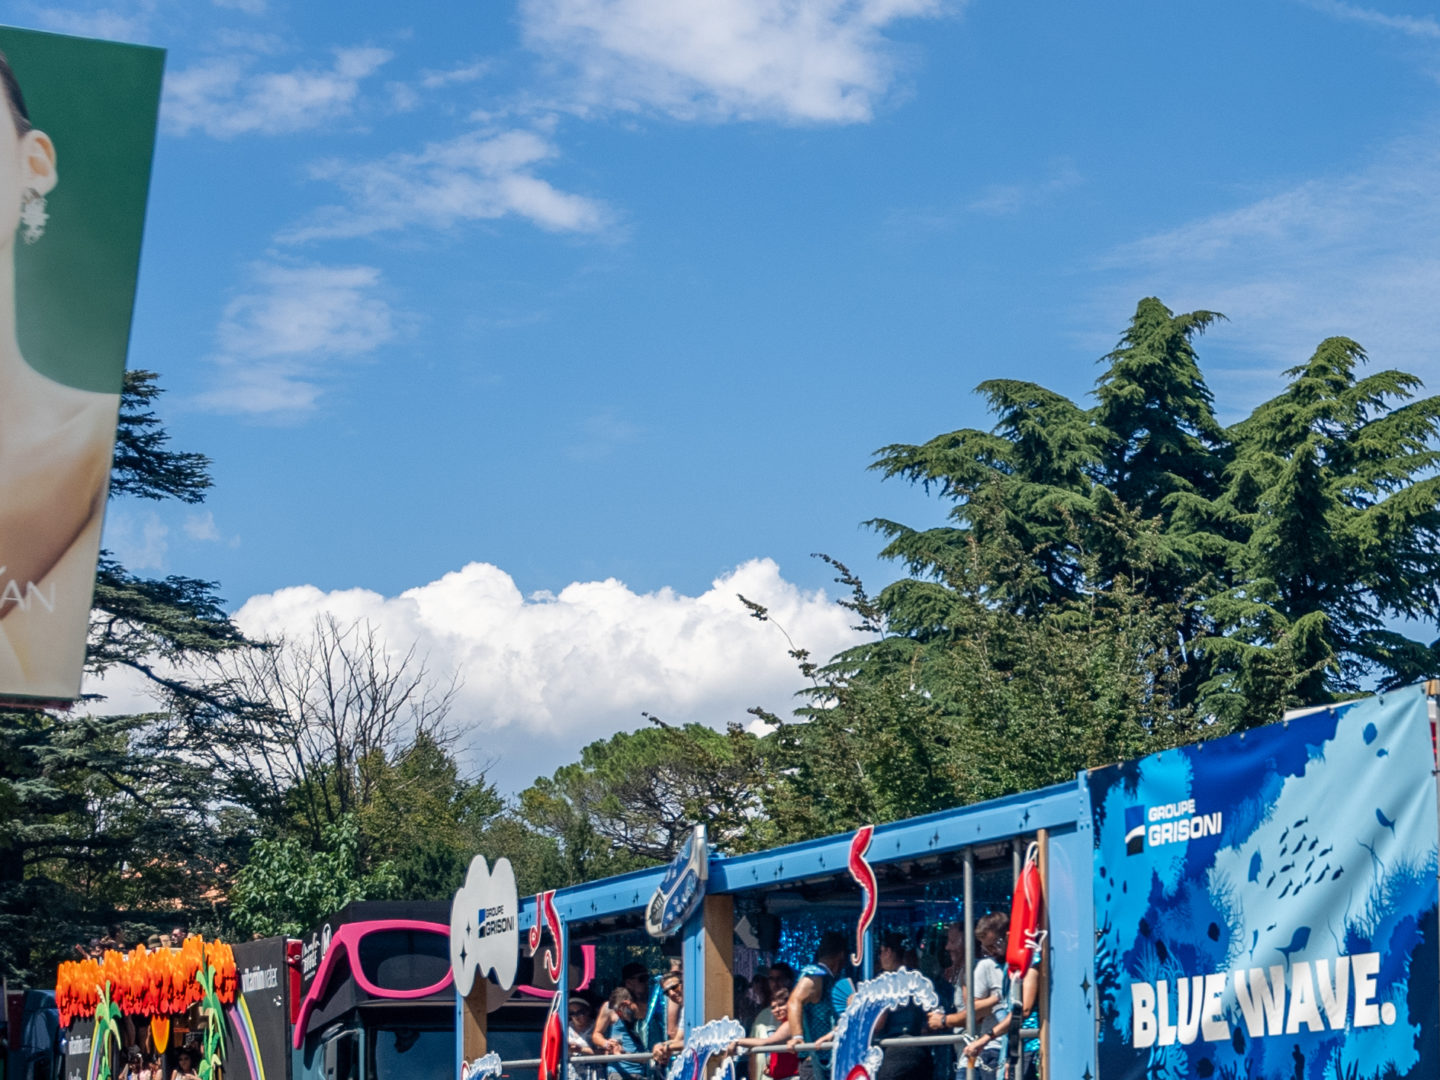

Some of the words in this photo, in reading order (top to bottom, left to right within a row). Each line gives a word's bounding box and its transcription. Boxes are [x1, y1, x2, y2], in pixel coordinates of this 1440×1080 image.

[0, 568, 55, 612] AN
[1148, 798, 1196, 822] GROUPE
[1148, 811, 1223, 847] GRISONI
[486, 904, 504, 918] GROUPE
[486, 915, 515, 936] GRISONI
[1131, 972, 1231, 1049] BLUE
[1234, 951, 1397, 1038] WAVE.
